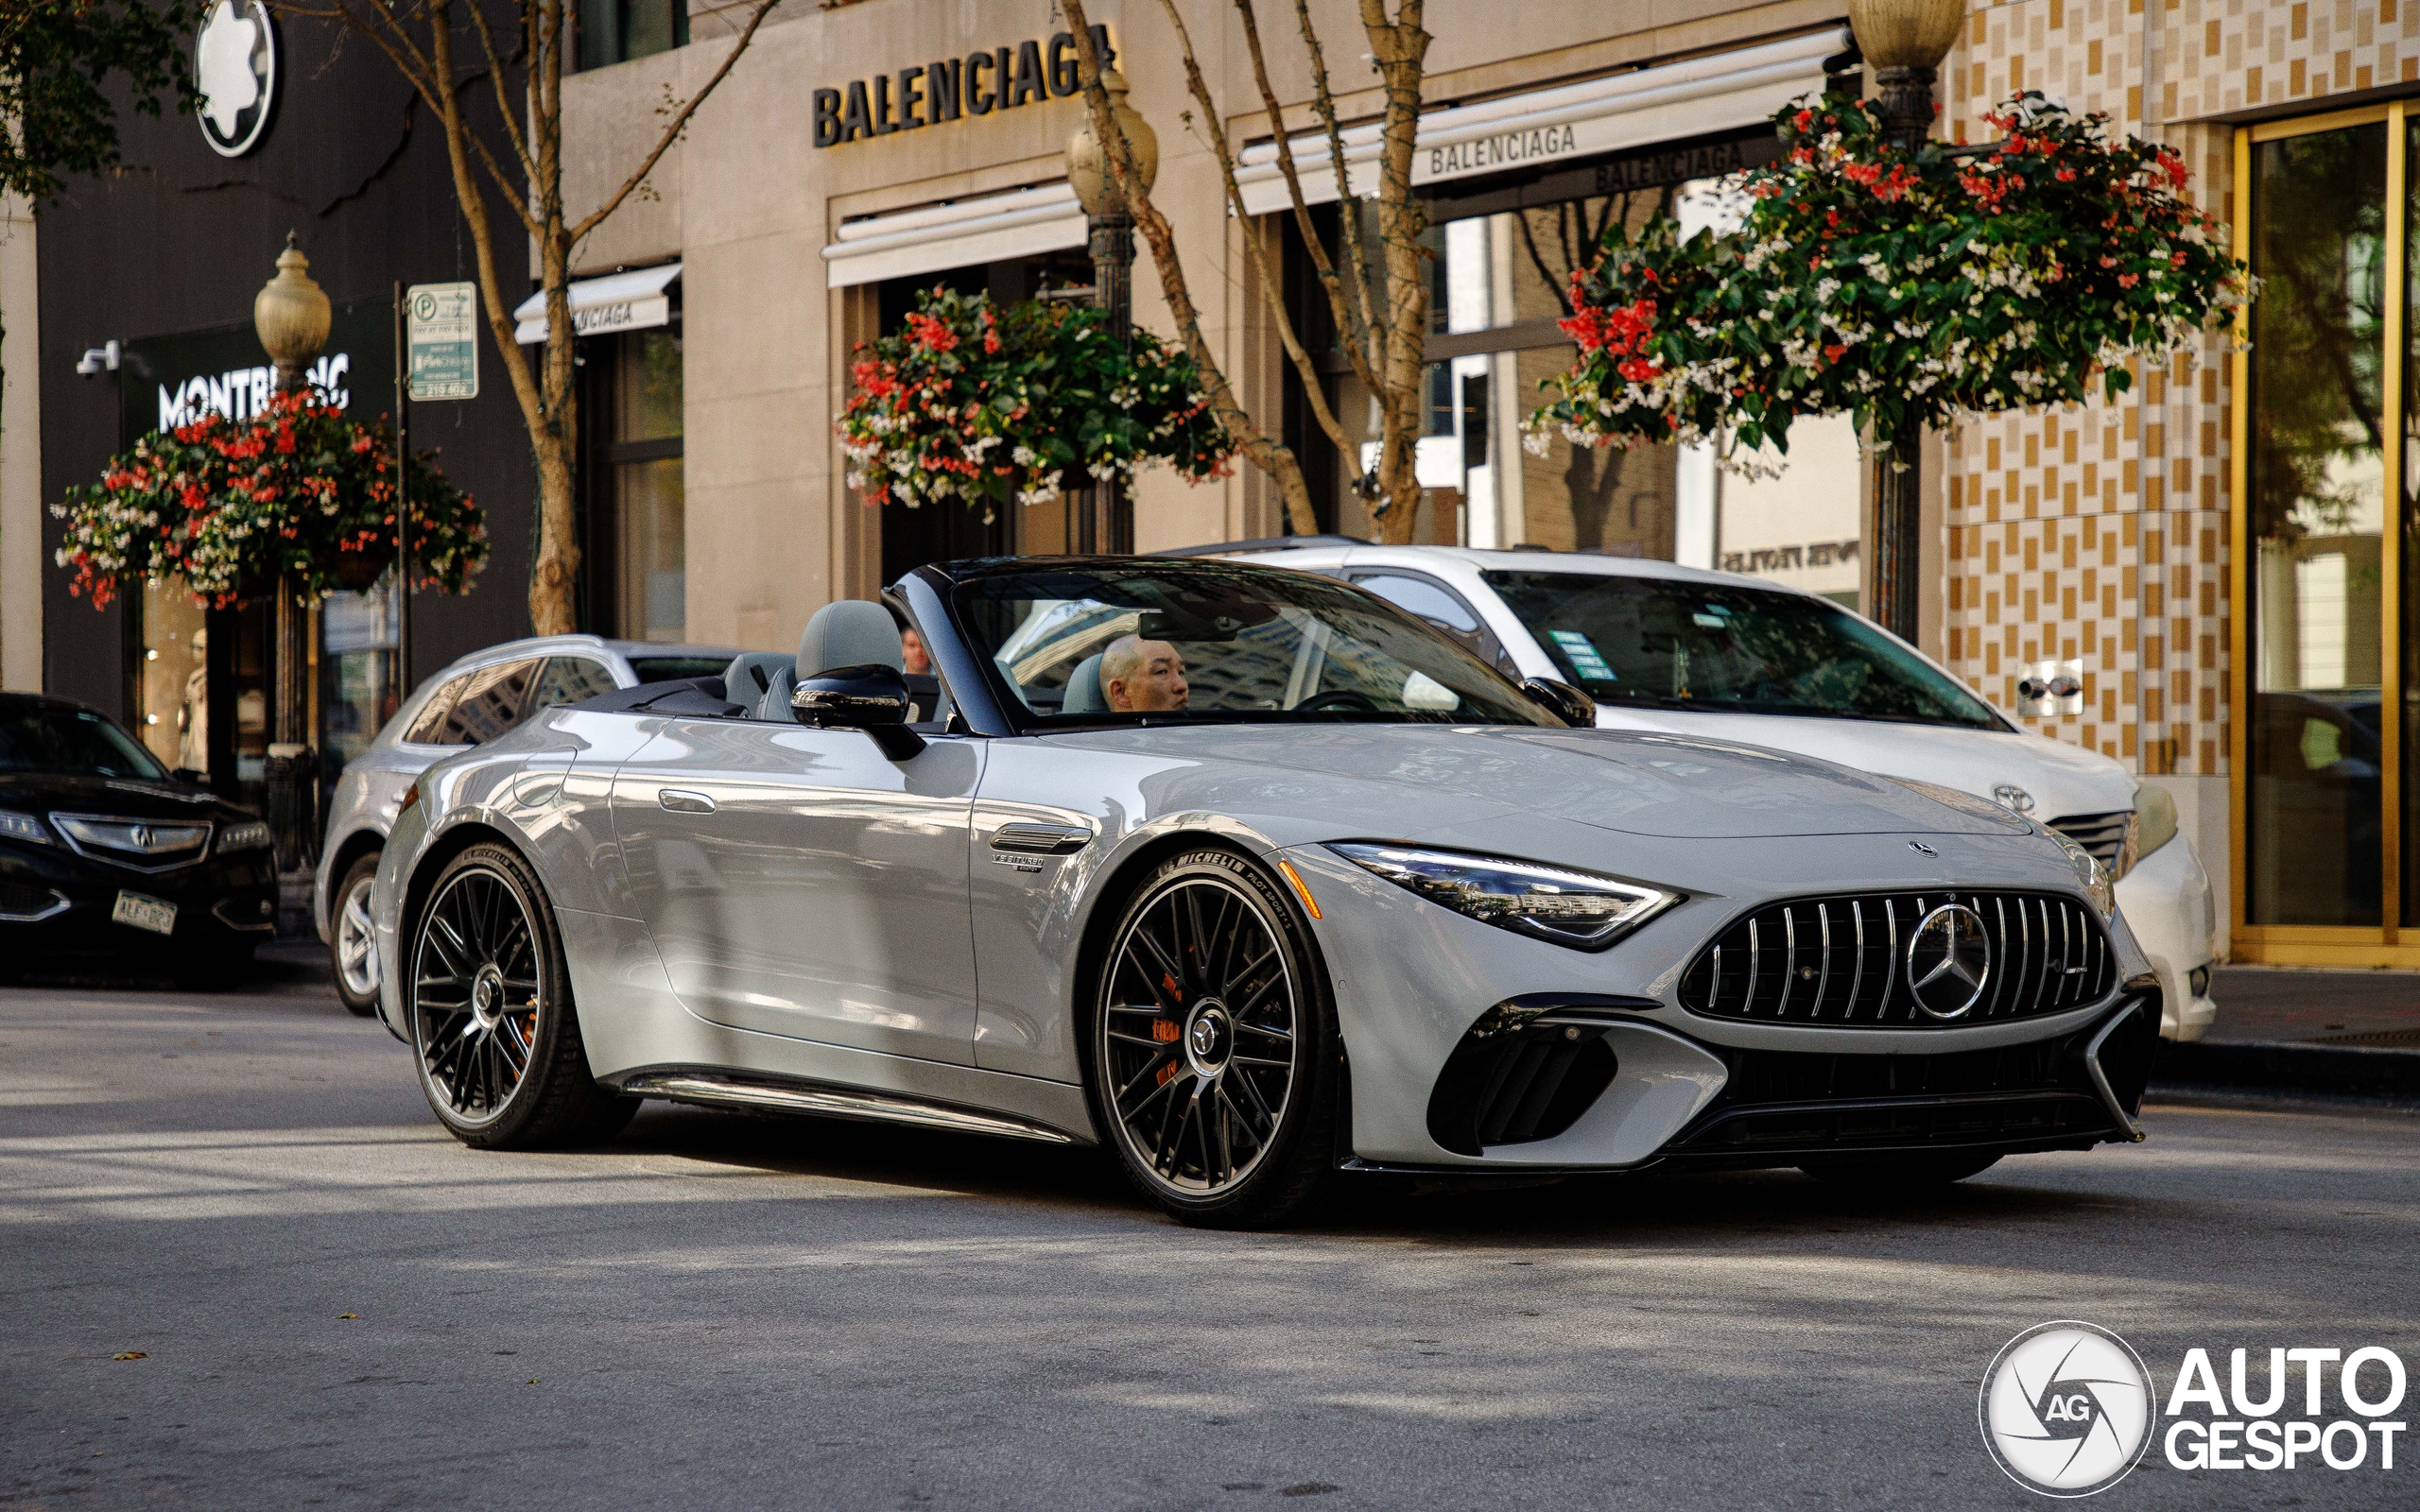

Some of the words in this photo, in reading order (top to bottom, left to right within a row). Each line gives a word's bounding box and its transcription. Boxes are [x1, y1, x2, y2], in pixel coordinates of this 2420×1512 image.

[1431, 125, 1576, 175] BALENCIAGA
[1177, 852, 1246, 873] MICHELIN
[1247, 872, 1267, 890] PILOT
[1265, 891, 1287, 917] SPORT
